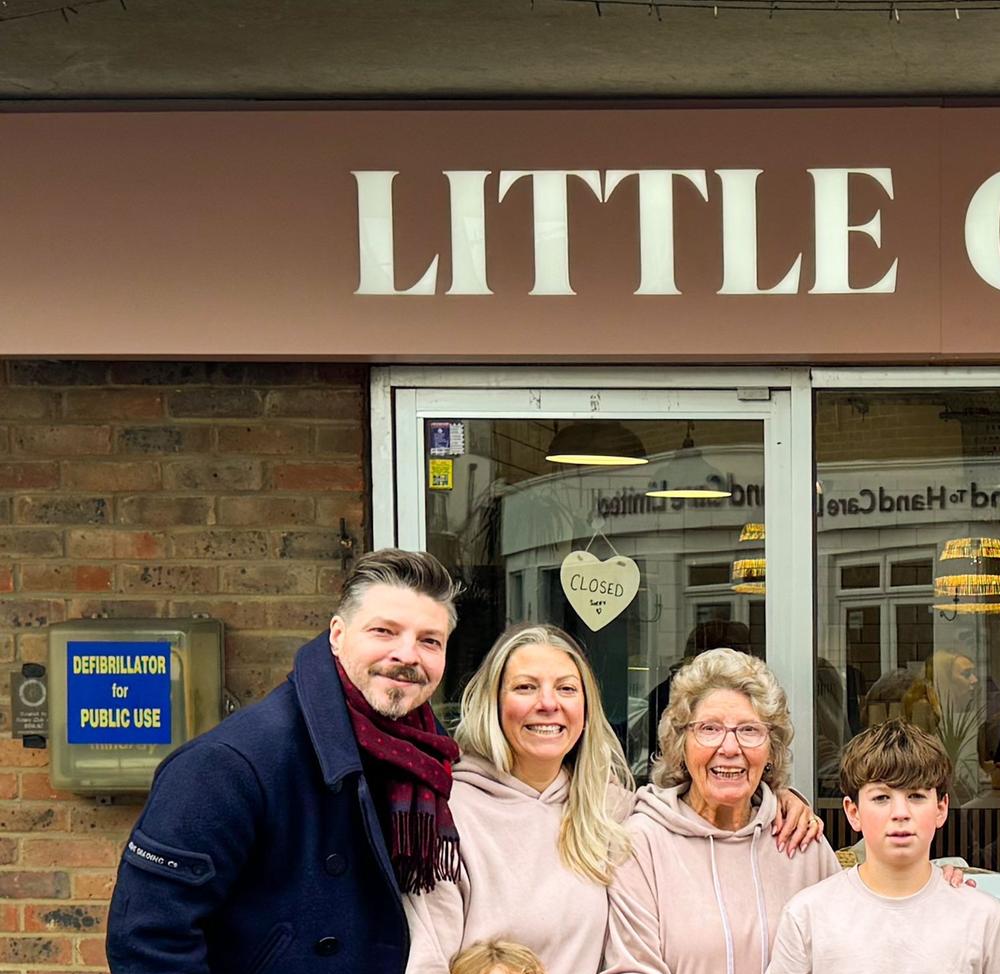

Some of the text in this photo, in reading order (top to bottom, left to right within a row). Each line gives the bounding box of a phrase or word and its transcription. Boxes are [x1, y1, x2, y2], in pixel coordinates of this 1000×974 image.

[350, 167, 899, 296] LITTLE
[570, 573, 624, 597] CLOSED
[73, 656, 166, 675] DEFIBRILLATOR
[112, 683, 128, 699] for
[80, 708, 161, 728] PUBLIC USE
